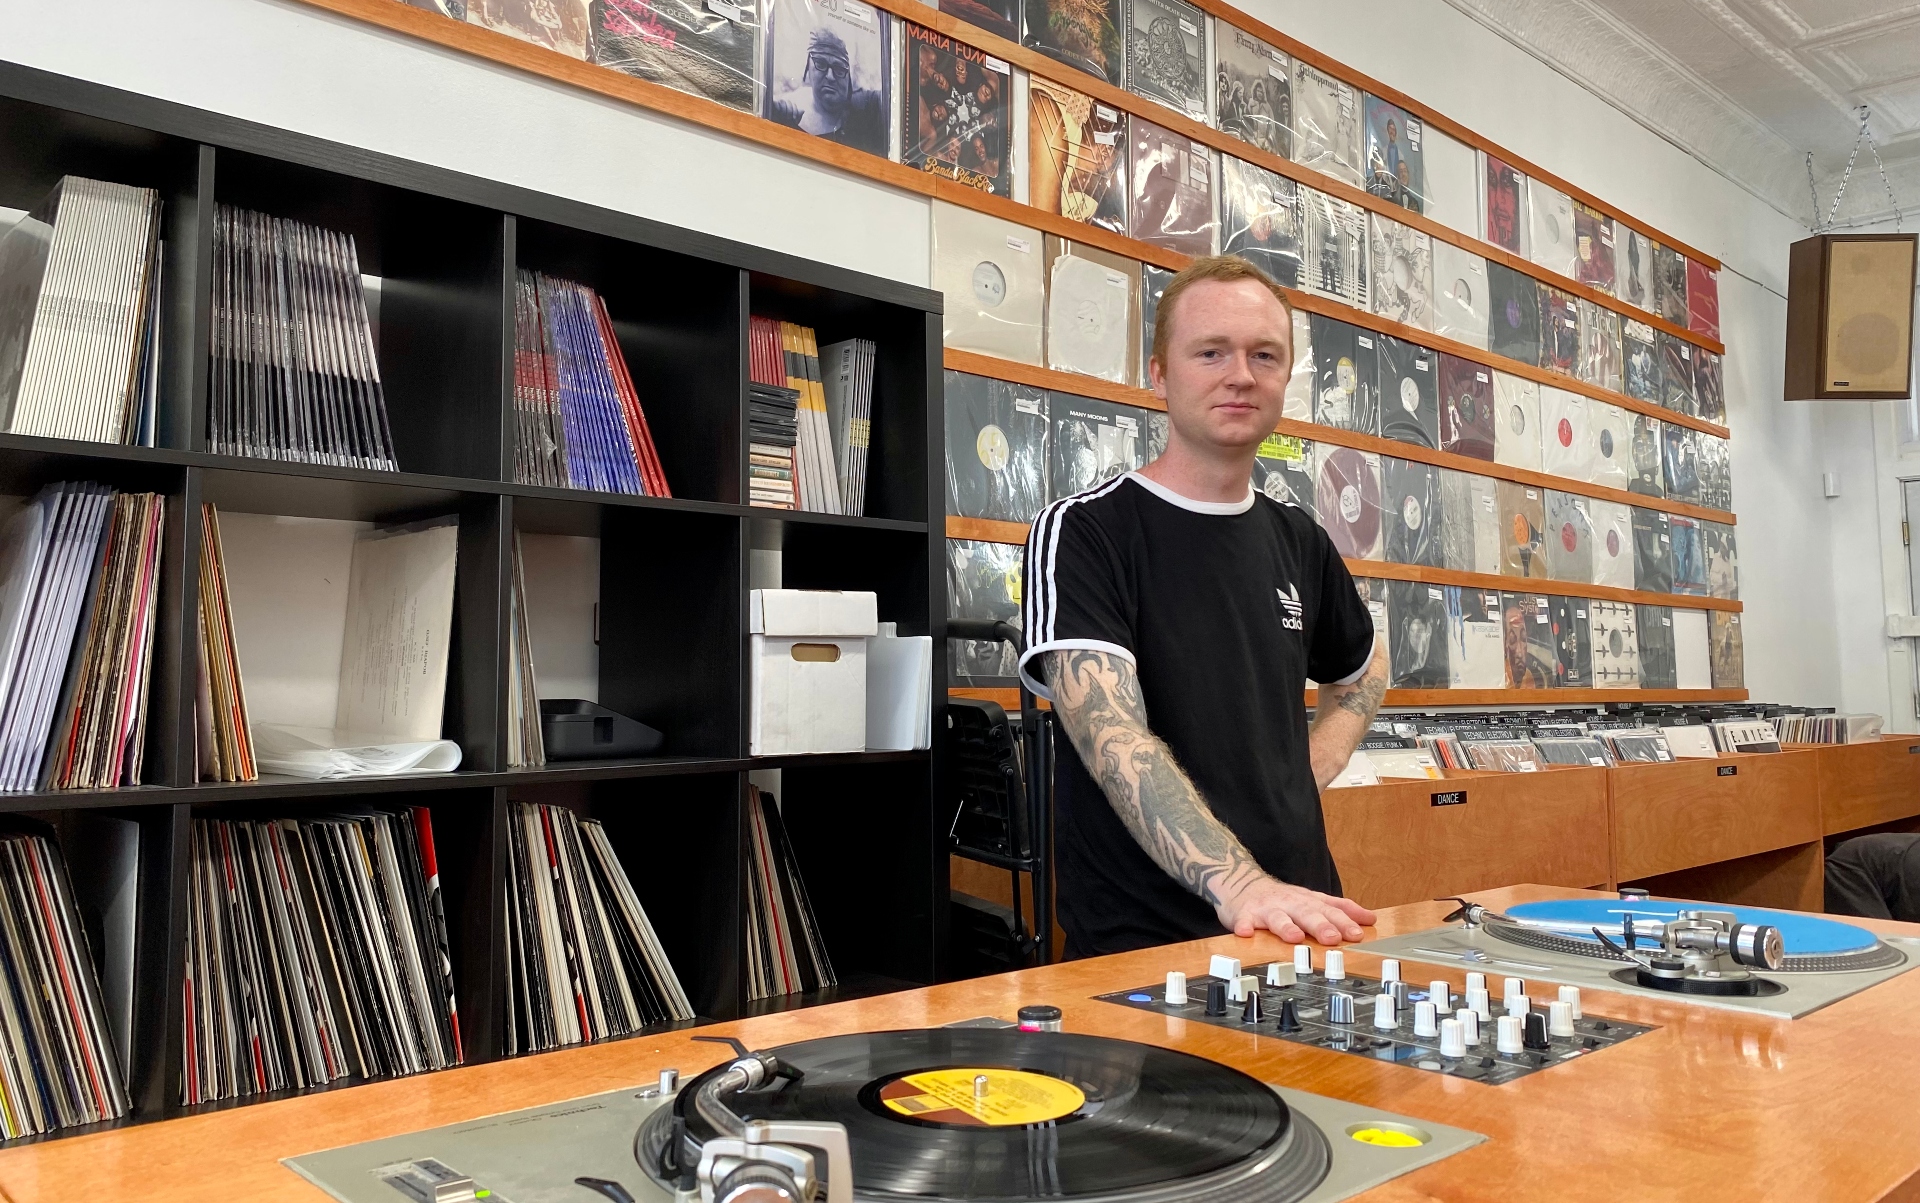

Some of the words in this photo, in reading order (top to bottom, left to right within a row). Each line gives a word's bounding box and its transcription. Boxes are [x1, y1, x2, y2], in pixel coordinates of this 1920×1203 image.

[906, 22, 950, 52] MARIA
[955, 42, 987, 67] FUM
[925, 156, 954, 178] Banda
[954, 166, 979, 190] Black
[1069, 410, 1087, 418] MANY
[1087, 413, 1109, 422] MOONS
[1282, 616, 1303, 631] adid
[1720, 766, 1733, 776] DANCE
[1437, 792, 1460, 805] DANCE
